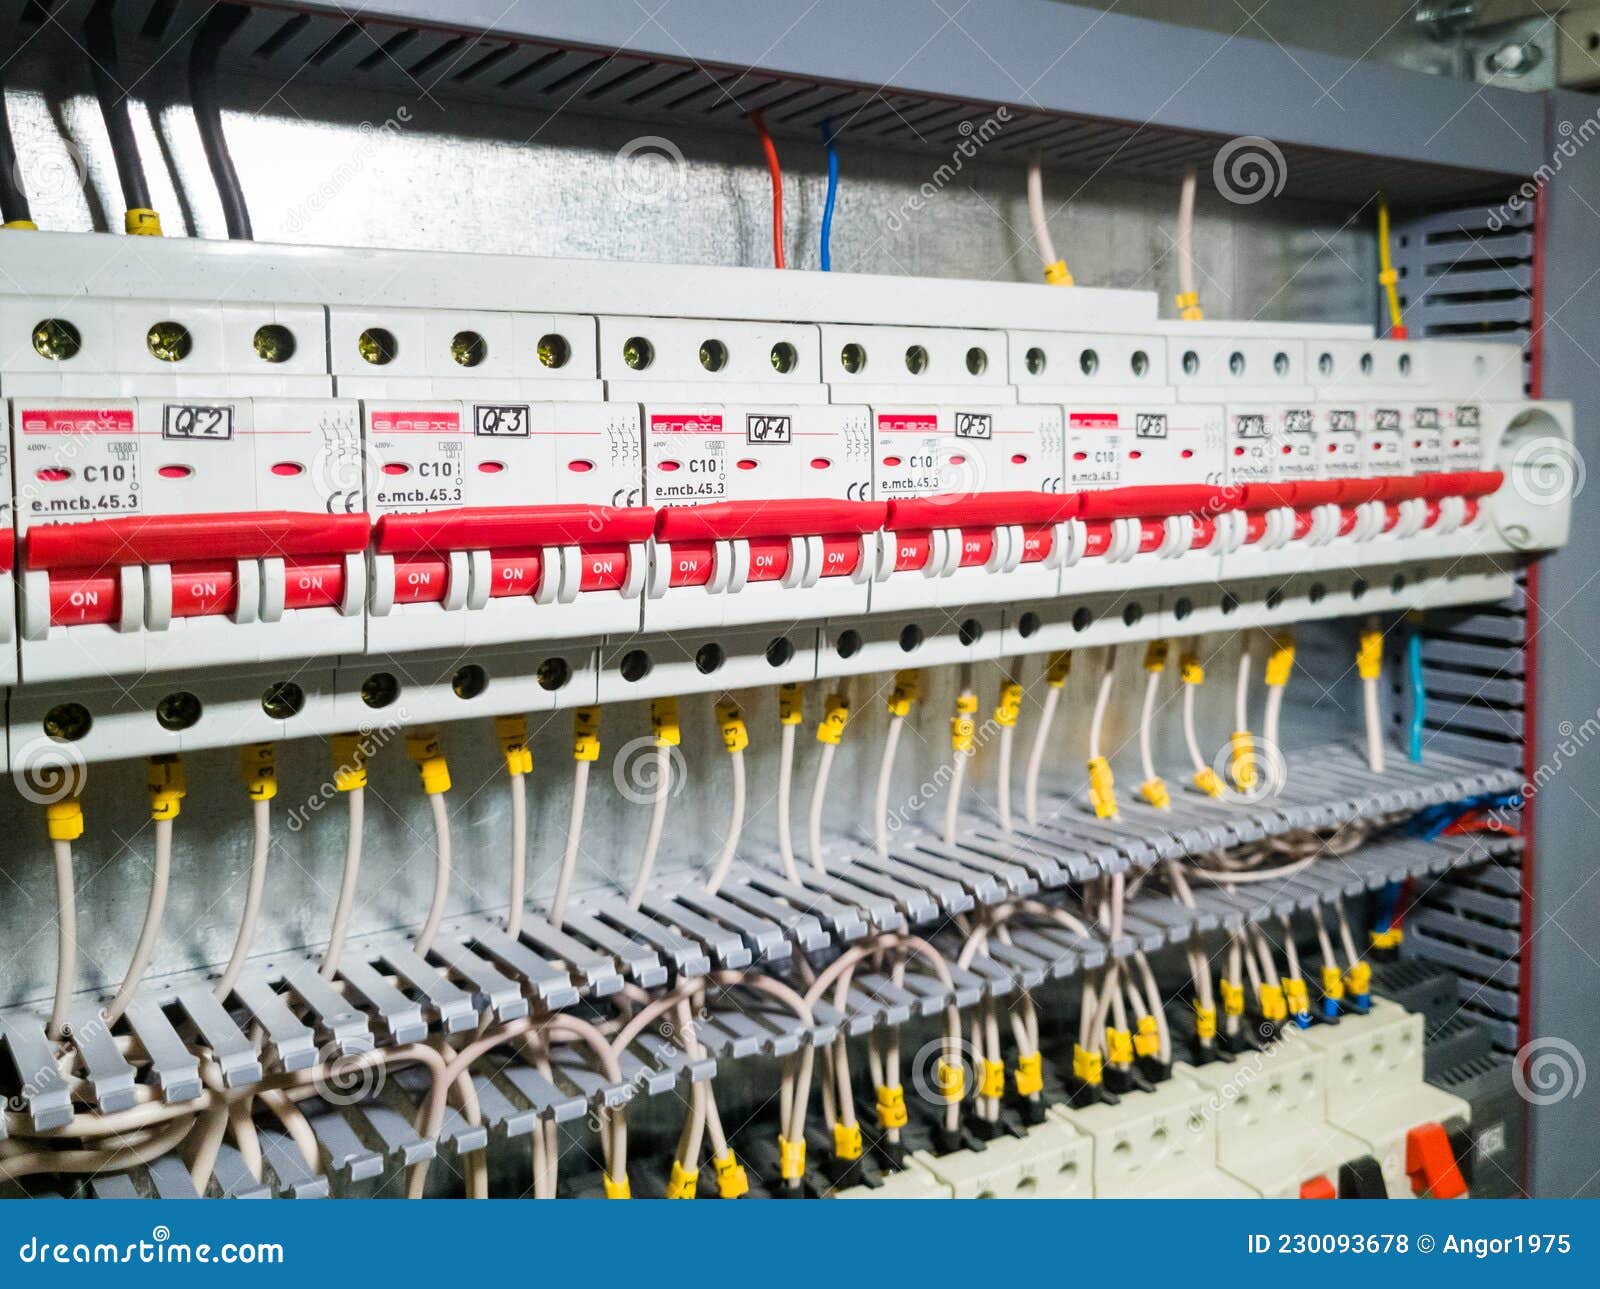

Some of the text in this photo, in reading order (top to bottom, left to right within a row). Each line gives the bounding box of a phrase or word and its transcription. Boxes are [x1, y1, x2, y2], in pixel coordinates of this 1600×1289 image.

[175, 406, 223, 437] QF2
[483, 410, 522, 433] QF3
[960, 416, 986, 436] QF5
[754, 420, 785, 439] QF4
[689, 459, 717, 473] C10
[910, 455, 933, 468] C10
[83, 465, 125, 483] C10
[419, 462, 452, 477] C10
[655, 482, 725, 496] e.mcb.45.3
[882, 477, 939, 489] e.mcb.45.3
[377, 488, 462, 502] e.mcb.45.3
[31, 494, 138, 512] e.mcb.45.3
[965, 543, 980, 552] ON
[1025, 540, 1040, 549] ON
[828, 553, 844, 563] ON
[901, 547, 917, 558] ON
[593, 562, 613, 573] ON
[679, 561, 697, 572] ON
[756, 556, 773, 566] ON
[408, 573, 430, 584] ON
[503, 568, 523, 580] ON
[299, 577, 323, 590] ON
[191, 584, 217, 597] ON
[70, 592, 98, 605] ON
